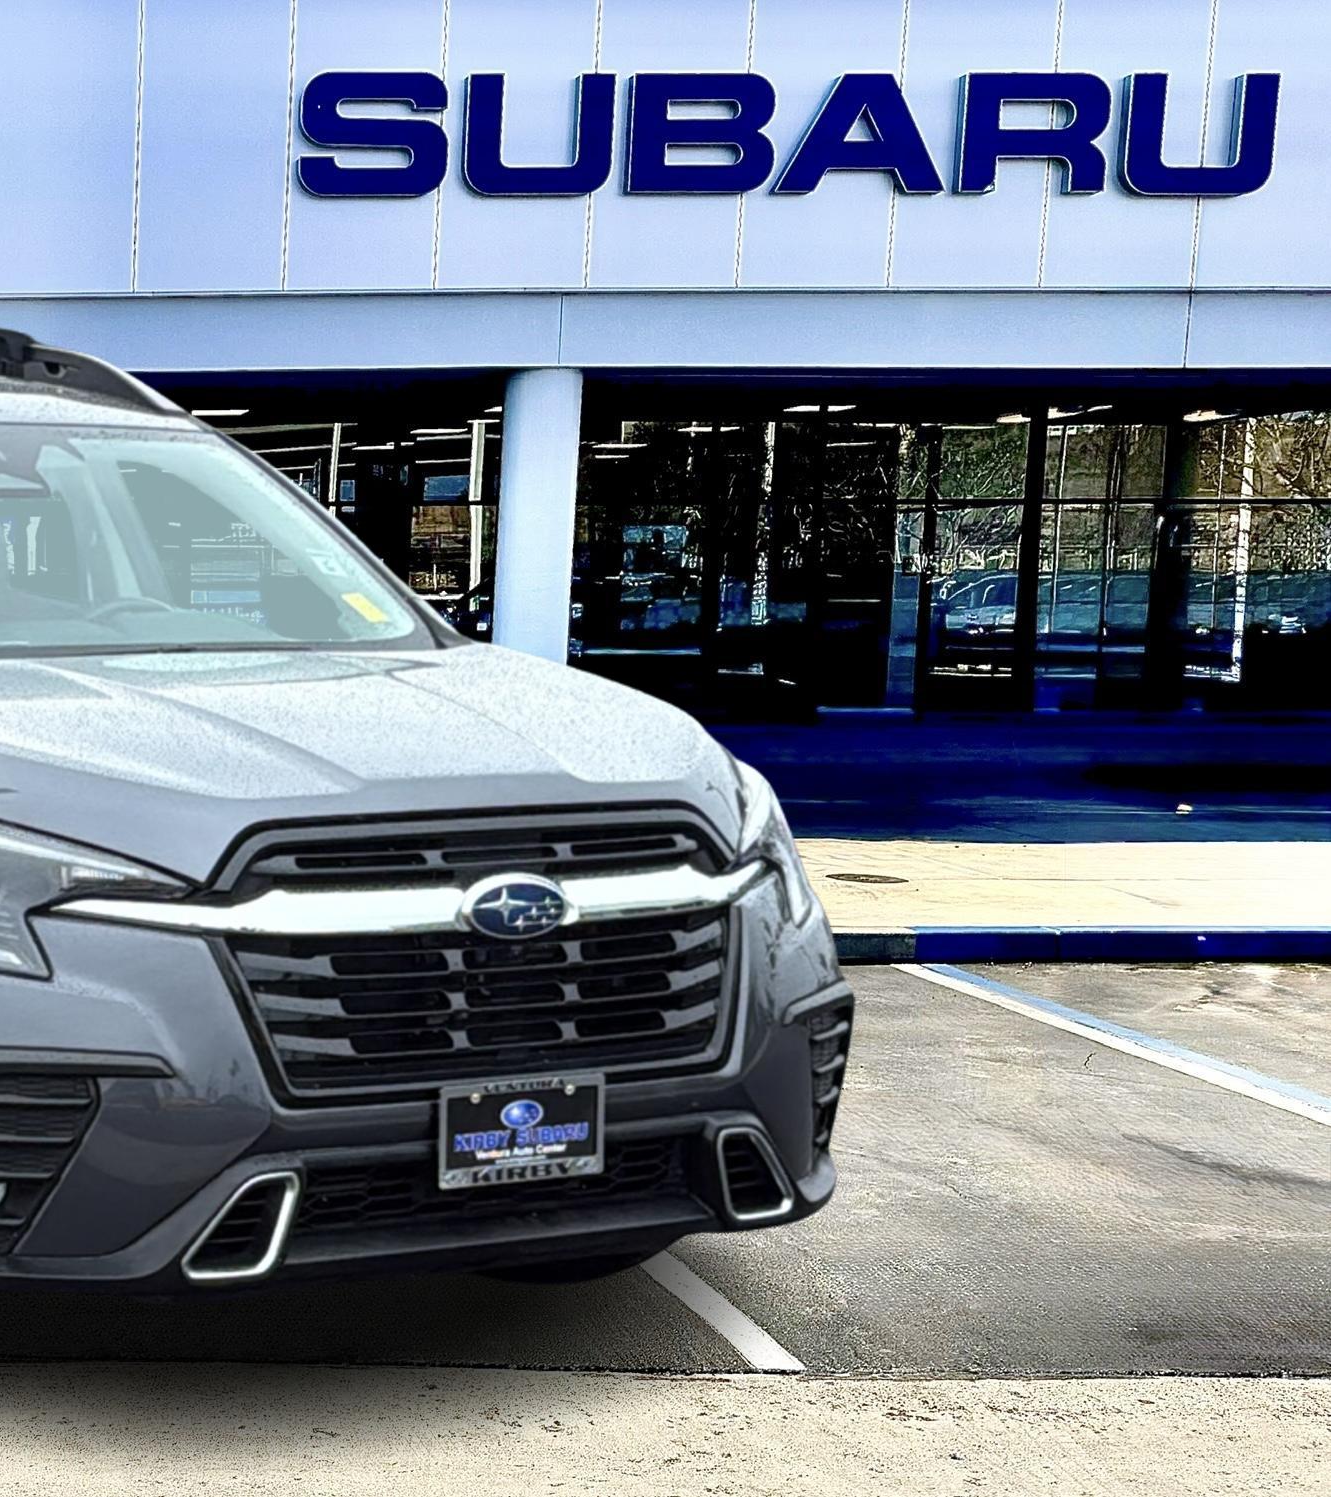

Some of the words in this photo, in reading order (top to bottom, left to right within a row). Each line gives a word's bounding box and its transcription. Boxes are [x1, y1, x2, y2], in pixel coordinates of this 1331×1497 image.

[296, 71, 1280, 197] SUBARU
[484, 1079, 565, 1093] VENTURA
[454, 1130, 511, 1152] KIRBY
[516, 1121, 589, 1146] SUBARU
[512, 1146, 535, 1156] Auto
[536, 1143, 568, 1154] Center
[472, 1162, 572, 1183] KIRBY
